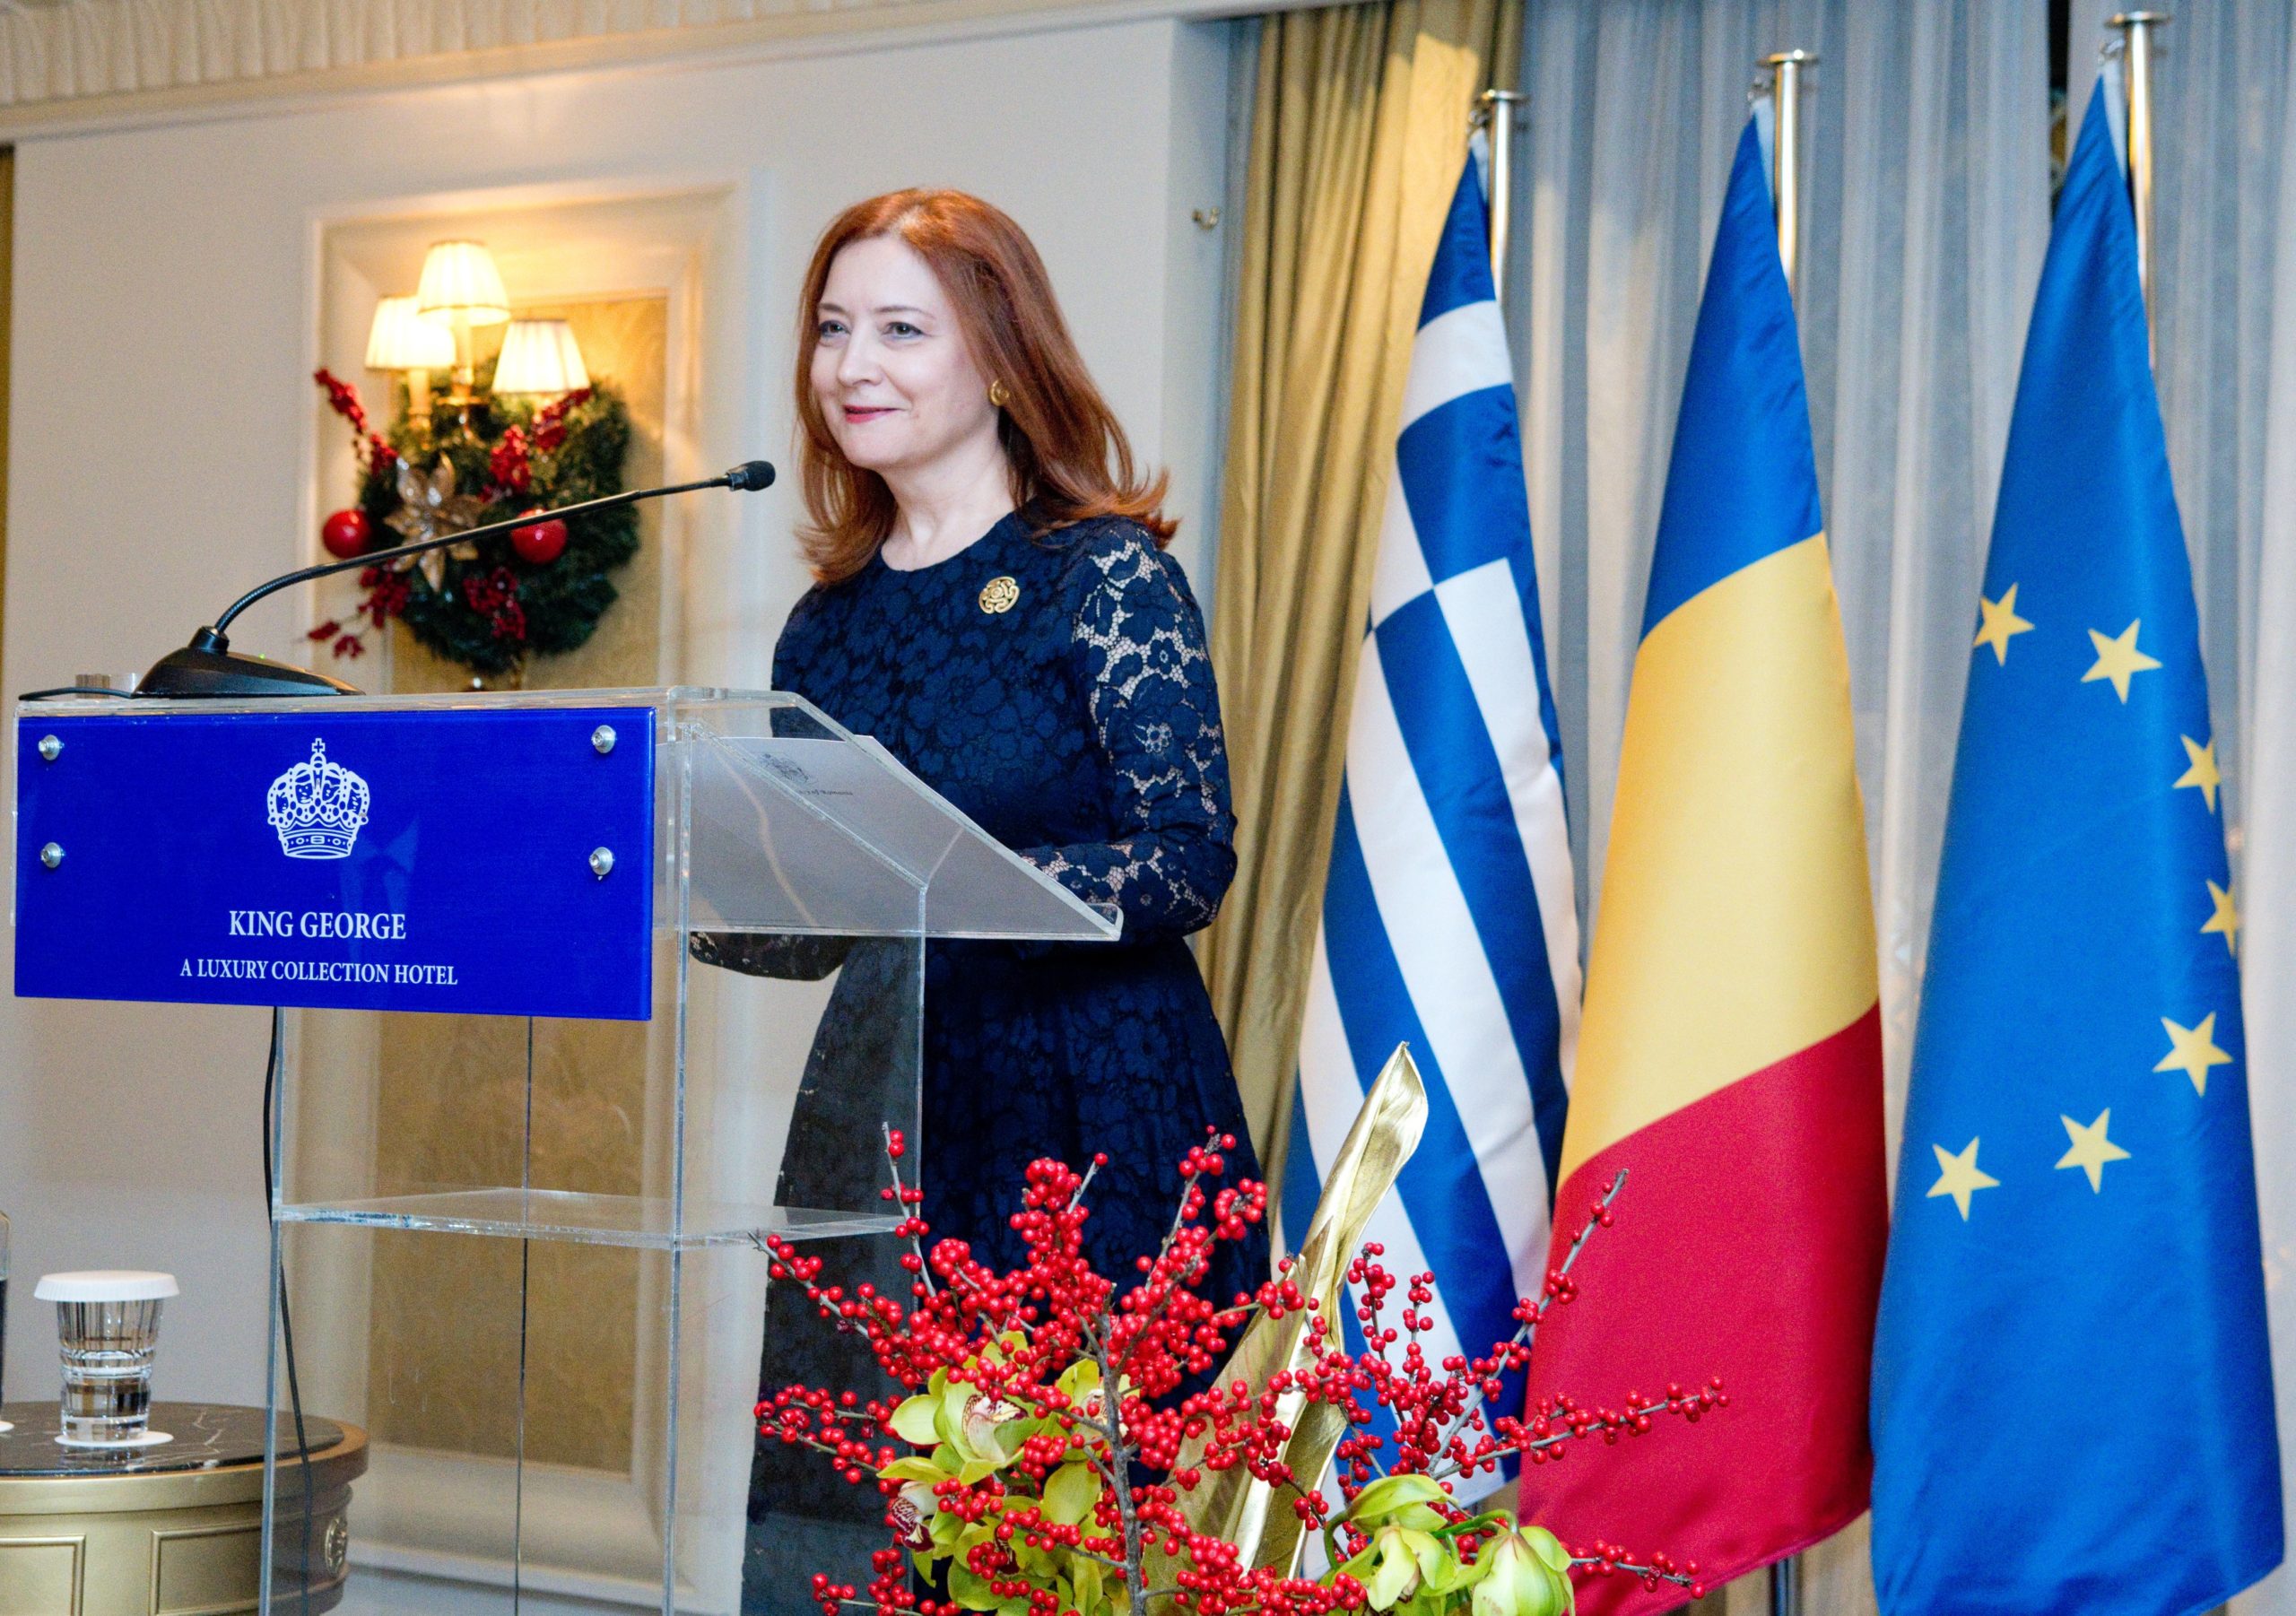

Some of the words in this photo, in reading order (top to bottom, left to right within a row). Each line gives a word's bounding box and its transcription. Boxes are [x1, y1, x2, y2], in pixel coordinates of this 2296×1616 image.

[229, 910, 294, 937] KING
[300, 912, 406, 940] GEORGE
[180, 959, 193, 977] A
[197, 959, 269, 979] LUXURY
[271, 960, 390, 983] COLLECTION
[394, 964, 458, 986] HOTEL
